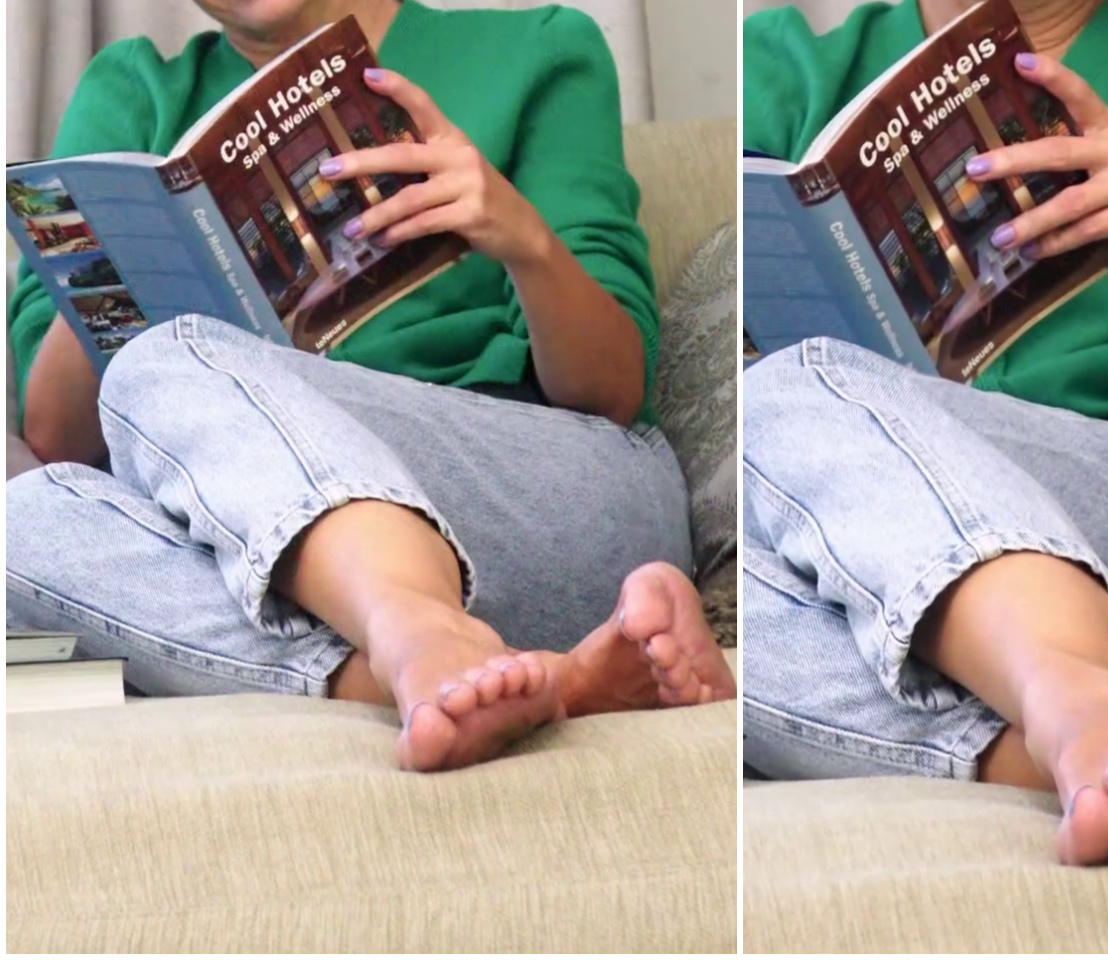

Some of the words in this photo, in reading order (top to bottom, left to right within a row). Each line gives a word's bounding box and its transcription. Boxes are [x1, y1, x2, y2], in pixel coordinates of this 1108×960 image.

[220, 110, 267, 163] Cool
[267, 55, 347, 118] Hotels
[242, 144, 268, 169] Spa
[267, 131, 280, 146] &
[279, 86, 341, 133] Wellness
[859, 105, 910, 167] Cool
[910, 38, 997, 113] Hotels
[883, 144, 910, 173] Spa
[910, 129, 924, 145] &
[922, 74, 990, 130] Wellness
[193, 208, 214, 234] Cool
[207, 235, 231, 271] Hotels
[830, 221, 853, 251] Cool
[845, 251, 871, 292] Hotels
[866, 292, 879, 311] Spa
